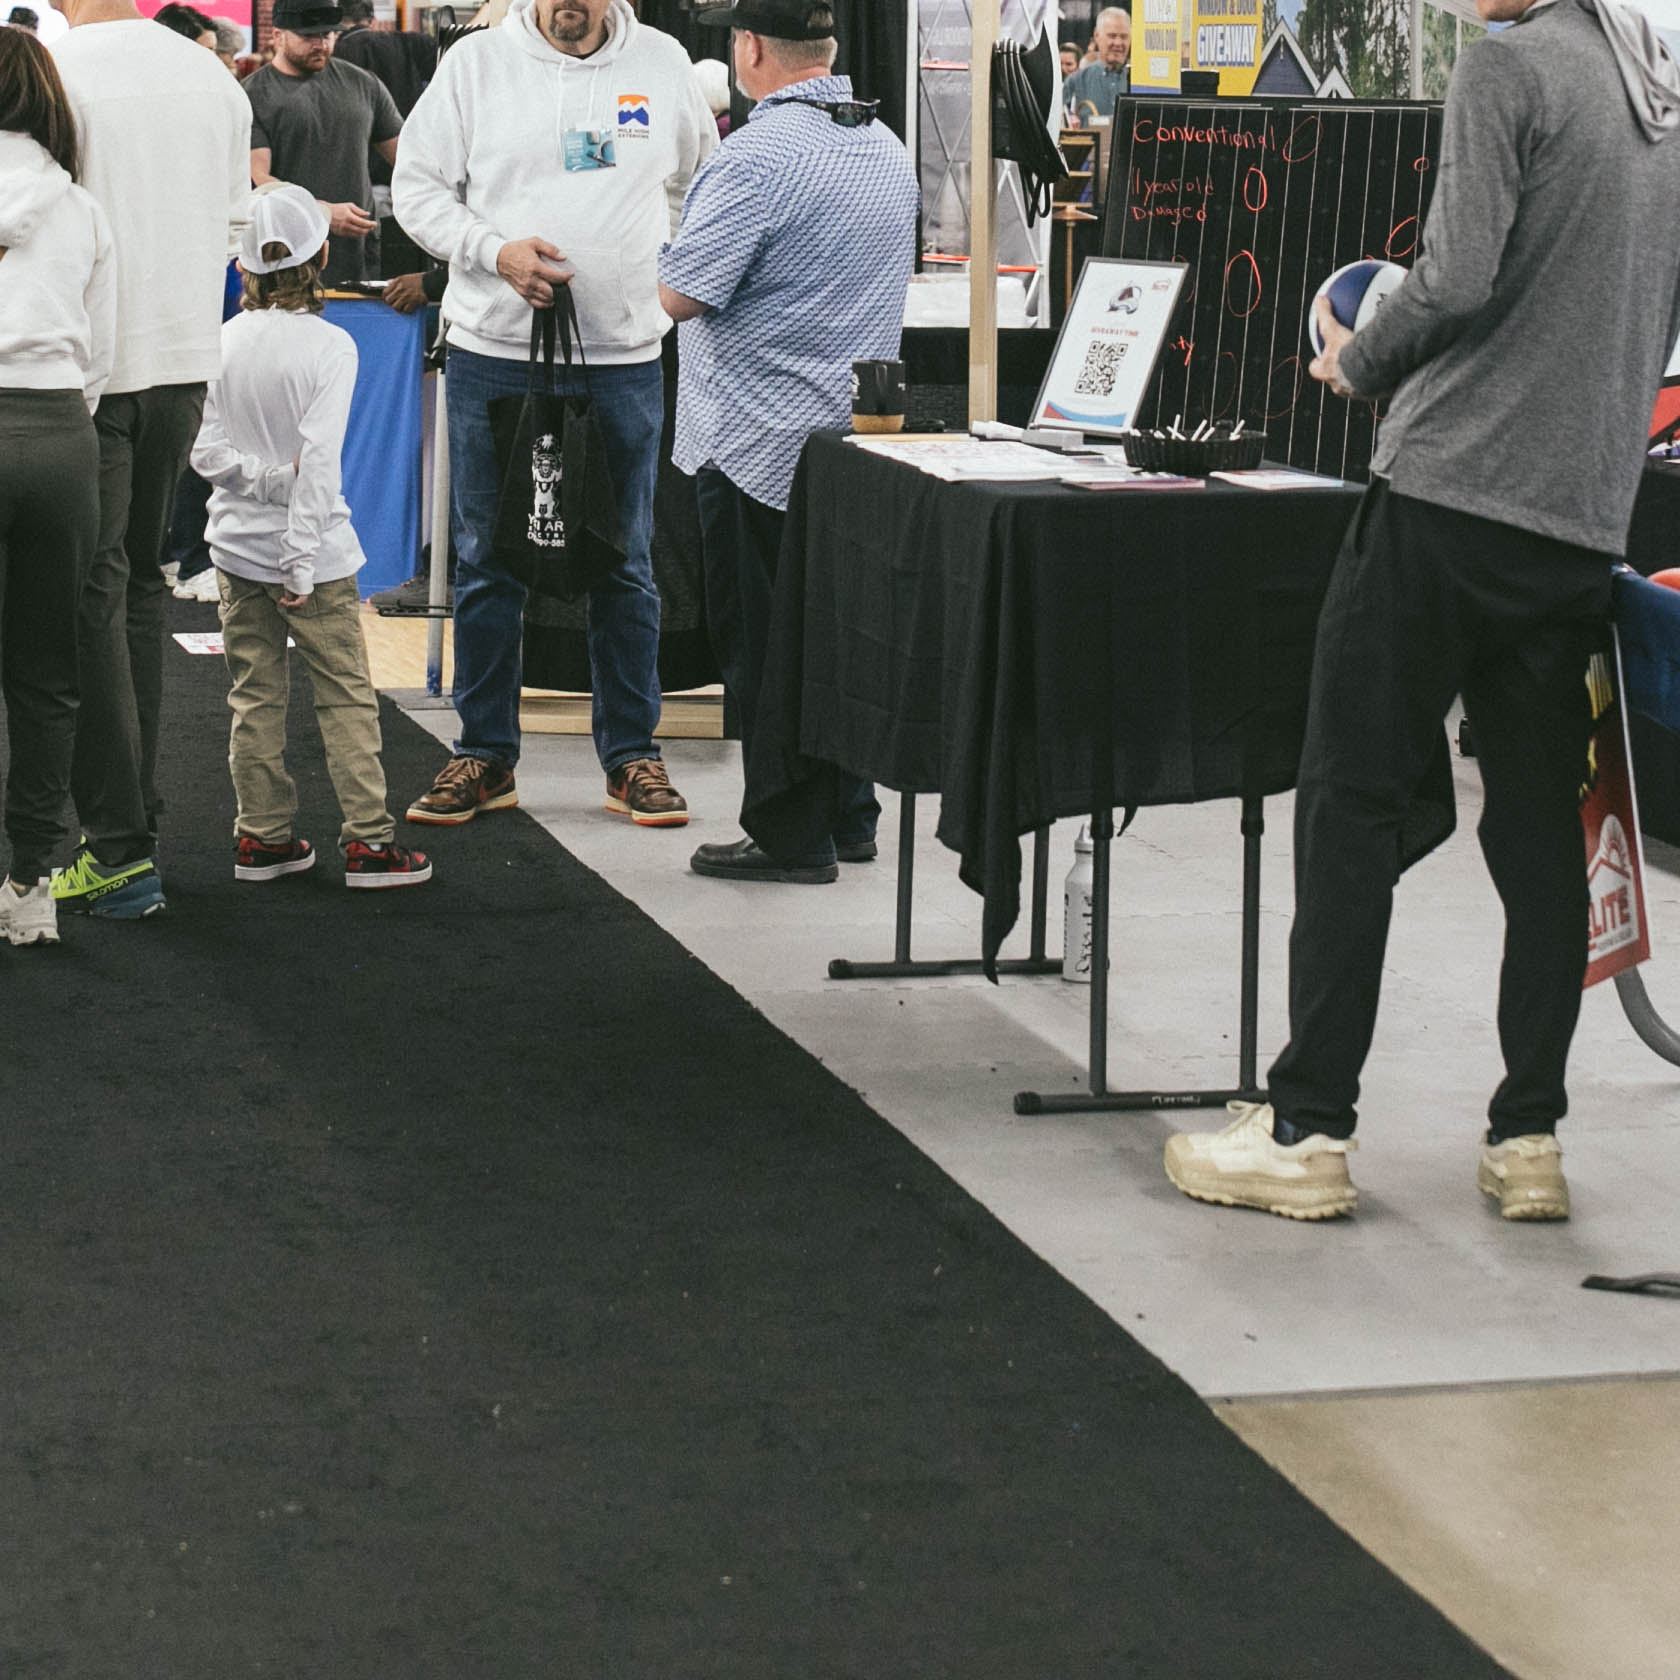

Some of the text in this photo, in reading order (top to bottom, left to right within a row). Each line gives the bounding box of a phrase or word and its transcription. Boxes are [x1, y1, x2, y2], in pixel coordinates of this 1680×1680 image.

[1196, 24, 1258, 68] GIVEAWAY
[1133, 120, 1276, 151] Conventional
[1143, 178, 1183, 206] year
[1186, 175, 1214, 196] old
[1131, 203, 1207, 226] Damaged
[1588, 885, 1631, 938] LITE
